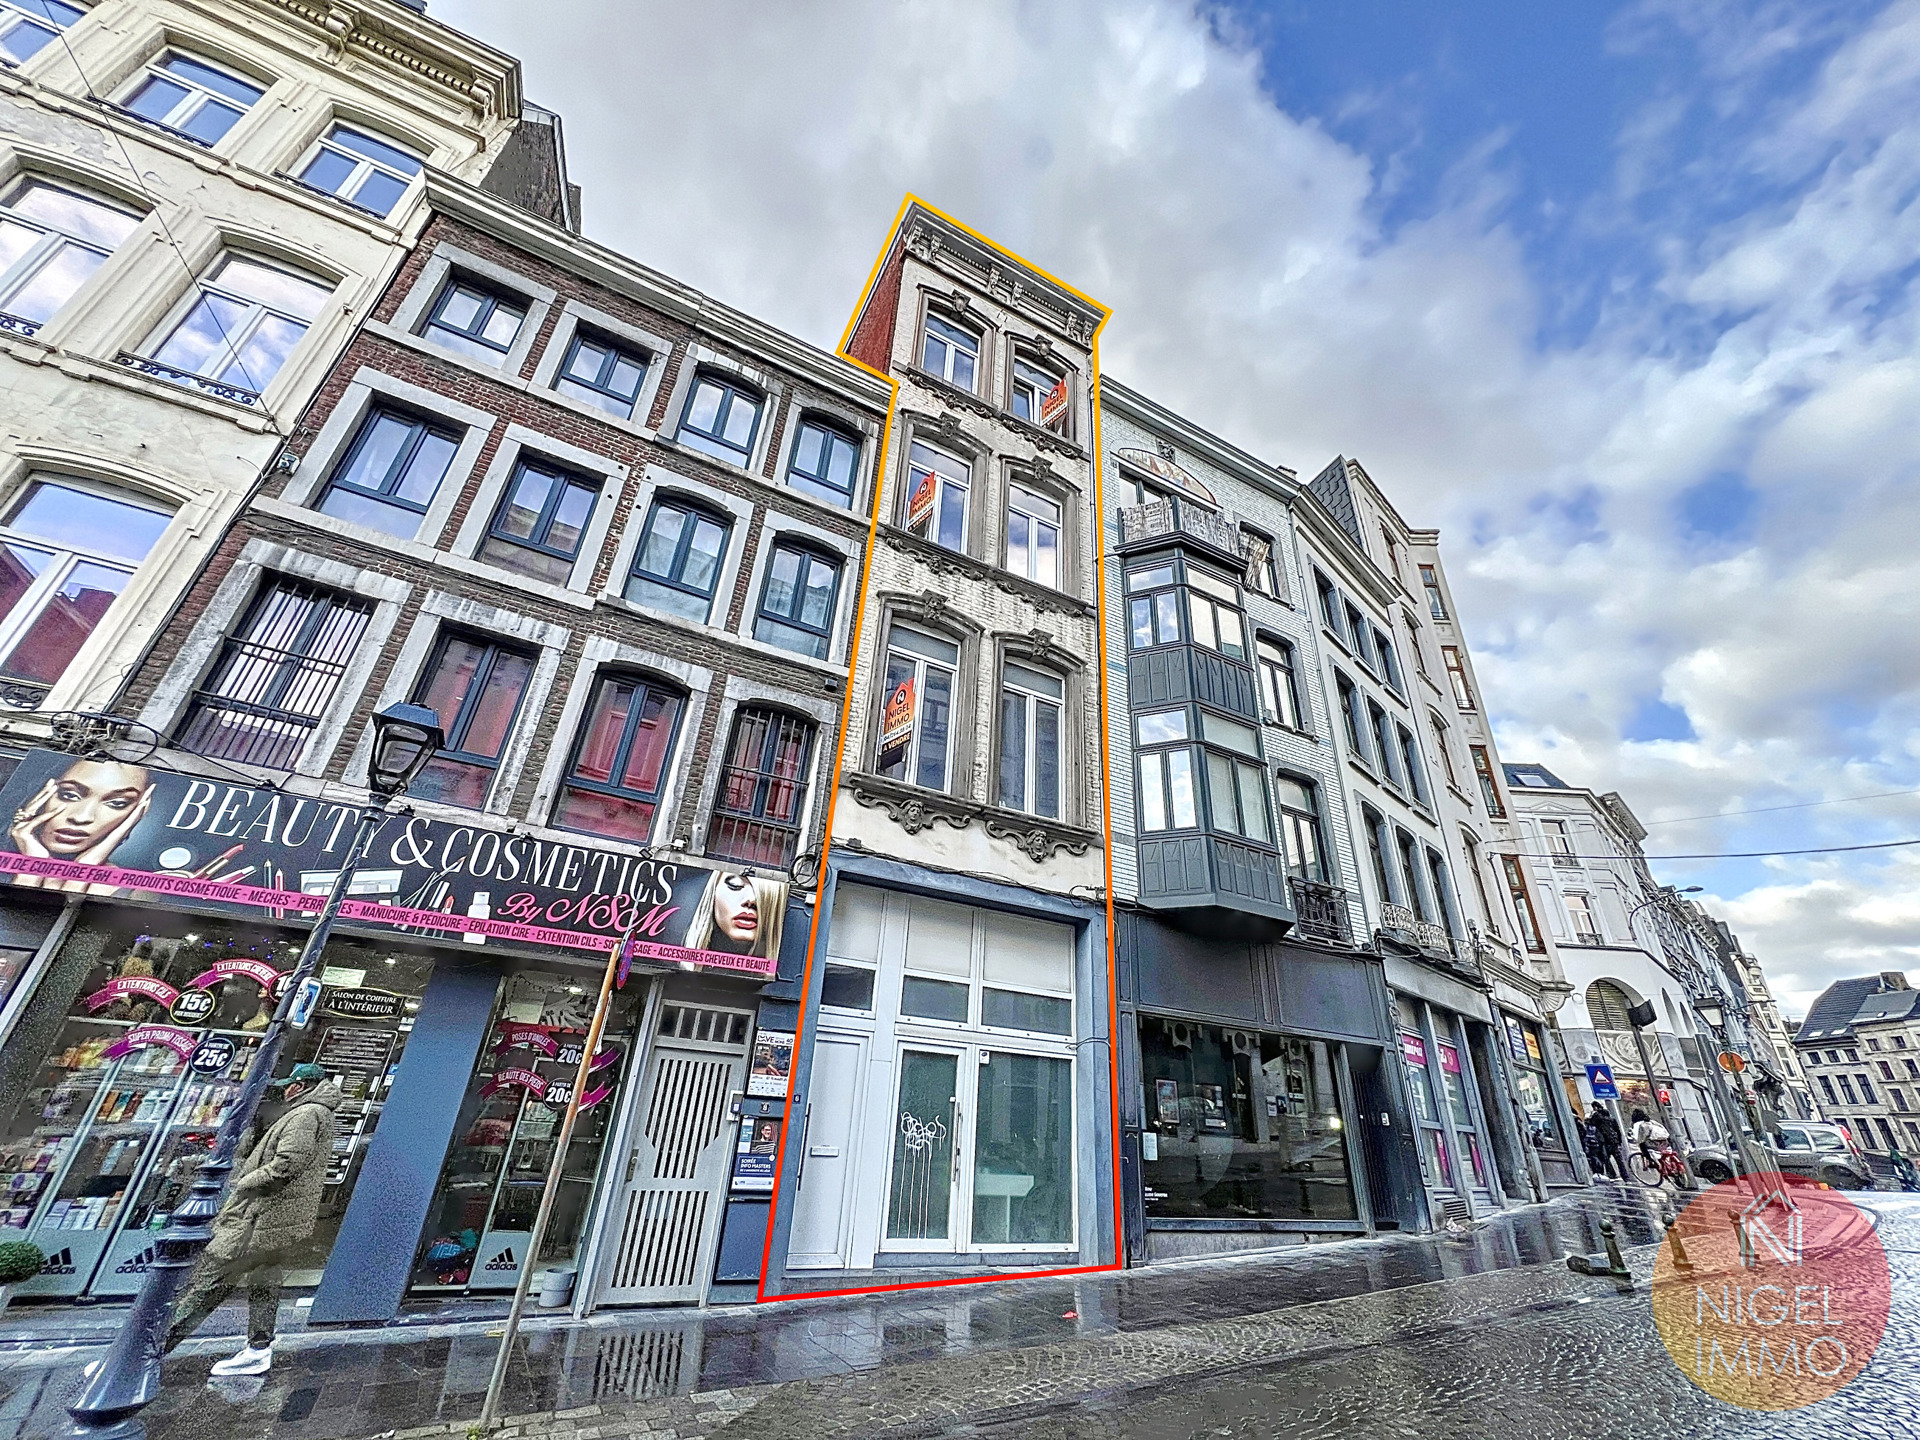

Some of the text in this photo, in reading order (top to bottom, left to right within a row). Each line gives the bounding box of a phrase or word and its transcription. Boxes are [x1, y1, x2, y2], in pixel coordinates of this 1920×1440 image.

[888, 702, 910, 720] NIGEL
[887, 713, 910, 732] IMMO
[888, 732, 911, 750] VENDRE
[166, 780, 679, 906] BEAUTY & COSMETICS
[0, 856, 11, 868] N
[11, 858, 31, 871] DE
[29, 860, 86, 879] COIFFURE
[86, 868, 113, 883] F&H
[119, 874, 174, 891] PRODUITS
[360, 906, 411, 923] MANUCURE
[412, 914, 419, 924] &
[511, 926, 531, 939] CIRE
[536, 930, 581, 946] EXTENTION
[580, 937, 598, 948] CILS
[657, 946, 705, 962] ACCESSOIRES
[704, 953, 736, 967] CHEVEUX
[736, 959, 745, 969] ET
[497, 892, 544, 925] By
[217, 961, 253, 972] EXTENTIONS
[117, 980, 171, 999] EXTENTIONS CILS
[332, 990, 355, 999] SALON
[365, 995, 397, 1004] COIFFURE
[179, 993, 212, 1011] 15€
[338, 1000, 394, 1014] L'INTÉRIEUR
[128, 1030, 150, 1043] SUPER
[511, 1032, 528, 1042] POSES
[194, 1048, 228, 1067] 25€
[519, 1072, 530, 1083] DES
[39, 1264, 77, 1275] didas
[485, 1262, 517, 1271] adidas
